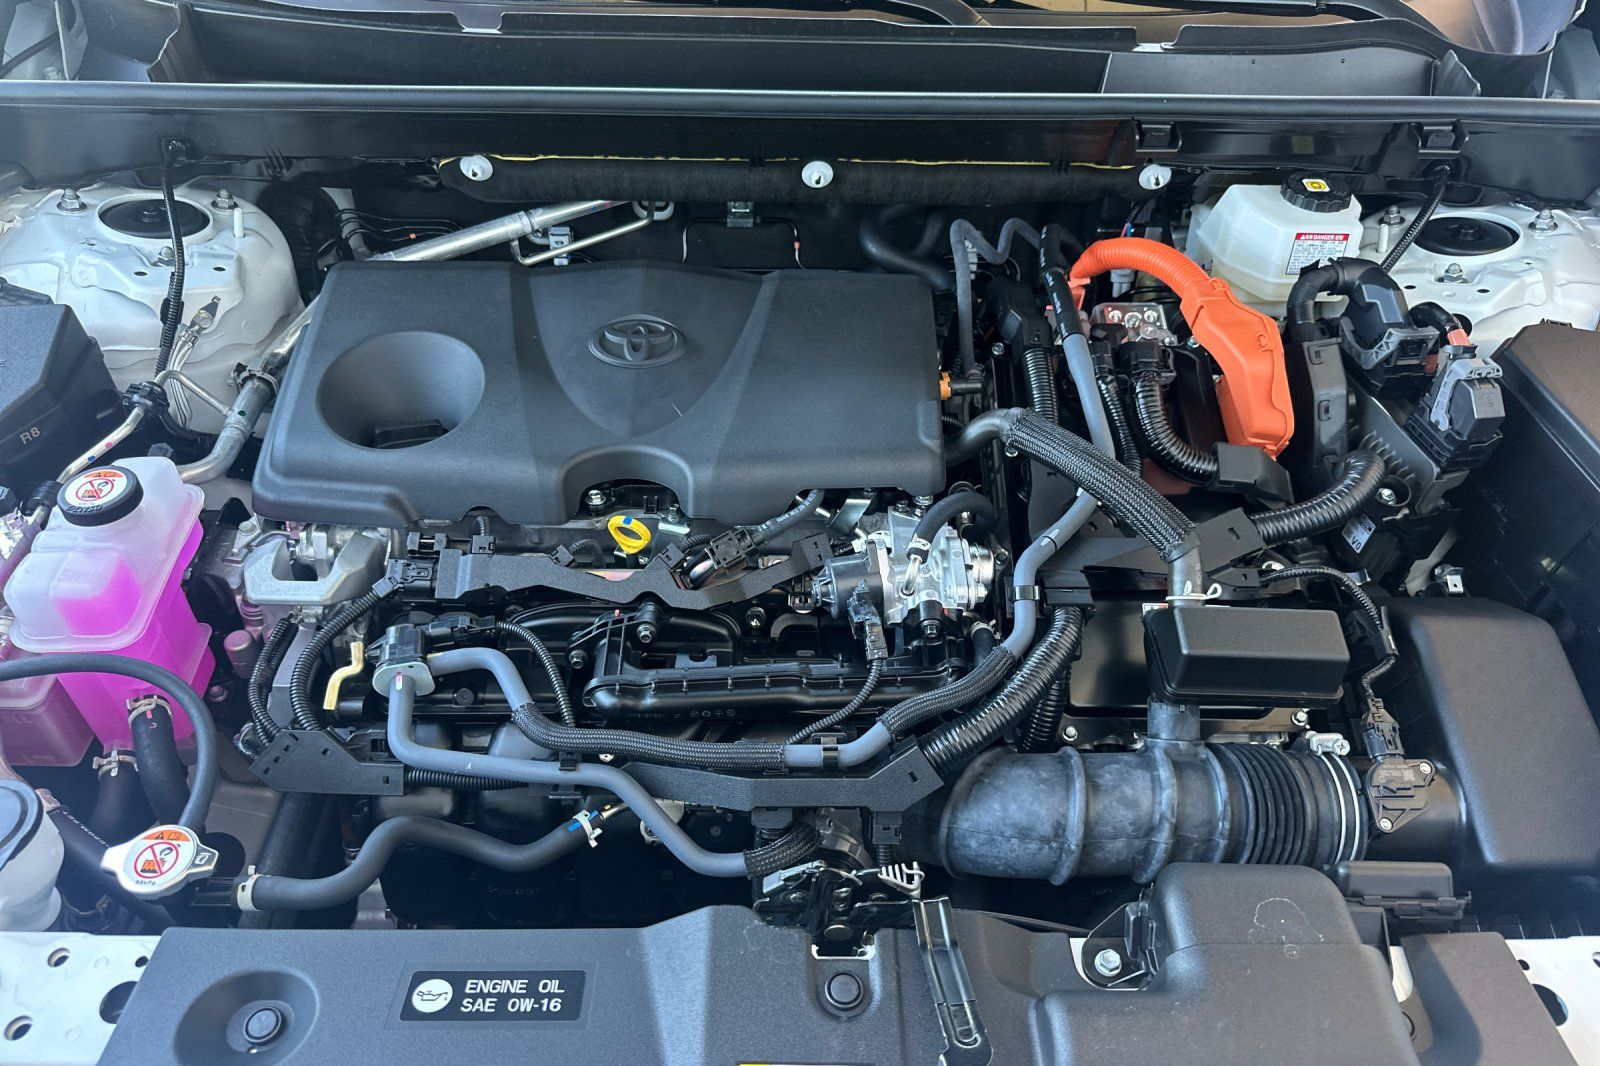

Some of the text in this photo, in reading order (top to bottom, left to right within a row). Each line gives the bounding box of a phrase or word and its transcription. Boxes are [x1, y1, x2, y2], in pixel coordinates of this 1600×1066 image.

[20, 426, 40, 444] R8
[464, 979, 565, 994] ENGINE OIL
[460, 998, 498, 1012] SAE
